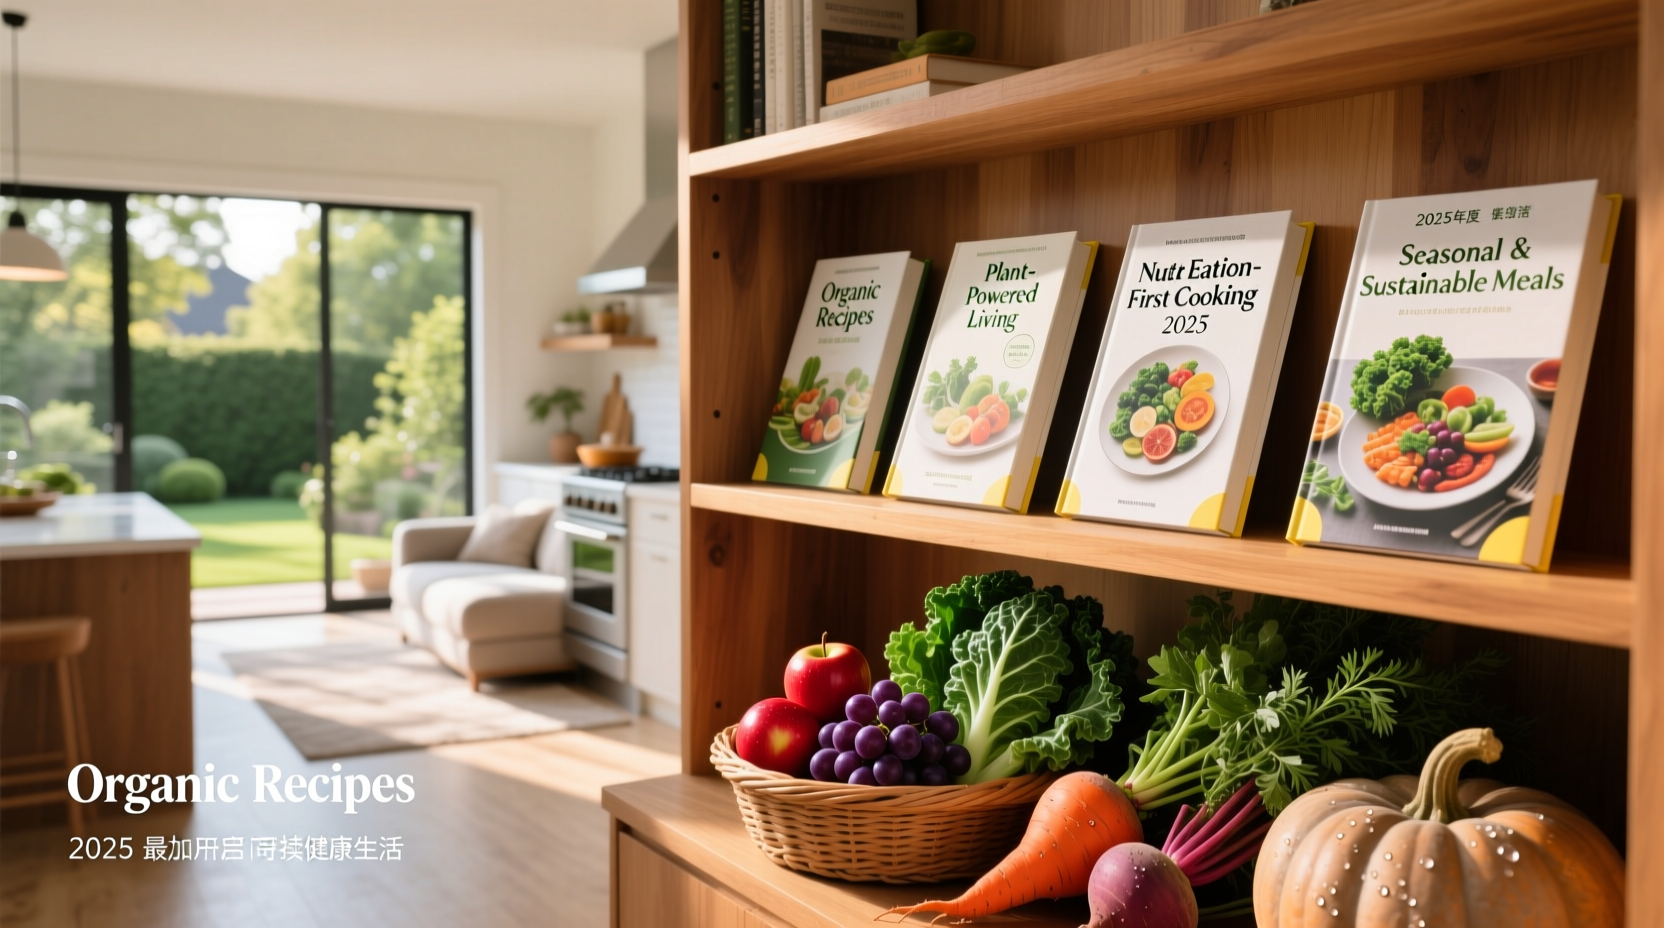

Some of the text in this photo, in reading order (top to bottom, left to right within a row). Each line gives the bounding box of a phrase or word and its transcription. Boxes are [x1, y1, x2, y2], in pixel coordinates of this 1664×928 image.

[1415, 209, 1481, 227] 2025年度
[1399, 236, 1532, 266] Seasonal &
[984, 261, 1036, 282] Plant-
[1187, 257, 1262, 280] Eation-
[1359, 265, 1565, 297] Sustainable Meals
[820, 279, 882, 308] Organic
[965, 282, 1040, 306] Powered
[1126, 284, 1259, 312] First Cooking
[815, 305, 875, 333] Recipes
[966, 308, 1020, 334] Living
[1161, 314, 1210, 335] 2025
